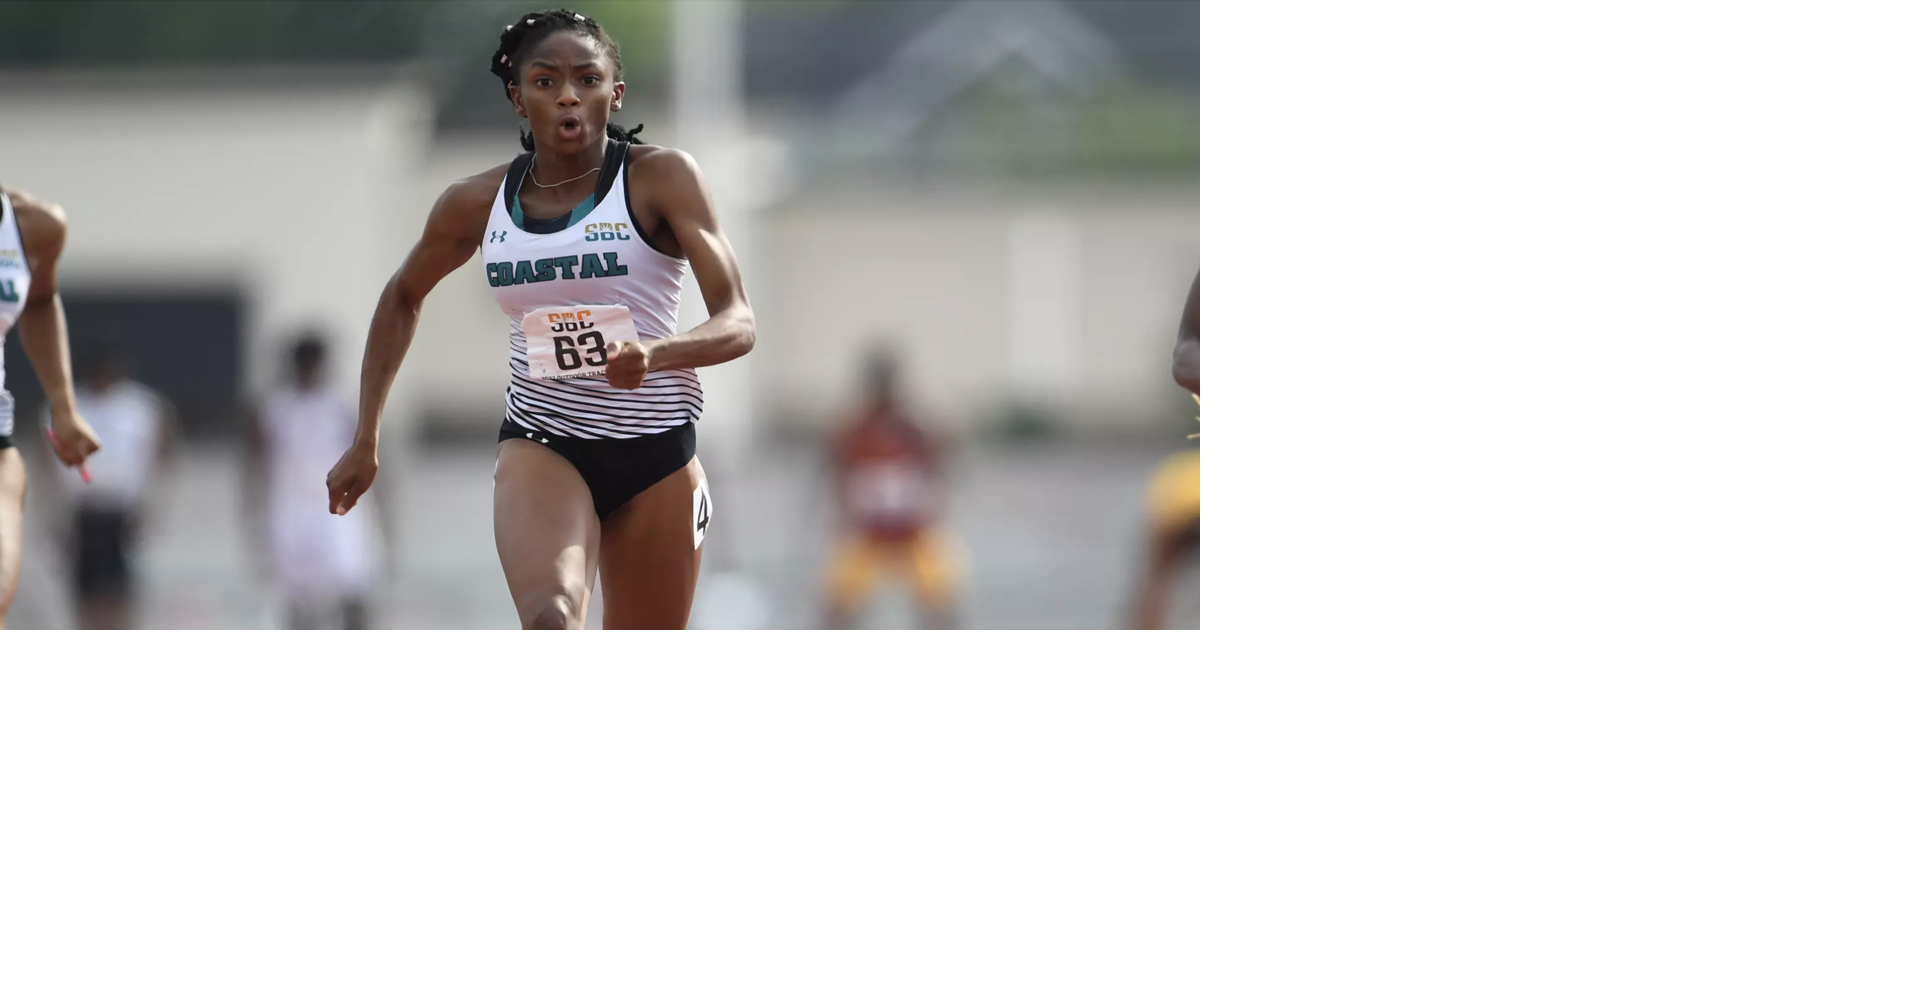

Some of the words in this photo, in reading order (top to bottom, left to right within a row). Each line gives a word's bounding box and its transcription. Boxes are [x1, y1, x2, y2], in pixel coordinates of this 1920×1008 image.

[584, 222, 631, 242] SBC
[486, 252, 628, 287] COASTAL
[548, 310, 594, 332] SBC
[553, 331, 607, 370] 63
[588, 369, 606, 377] TRAC
[697, 486, 710, 537] 4
